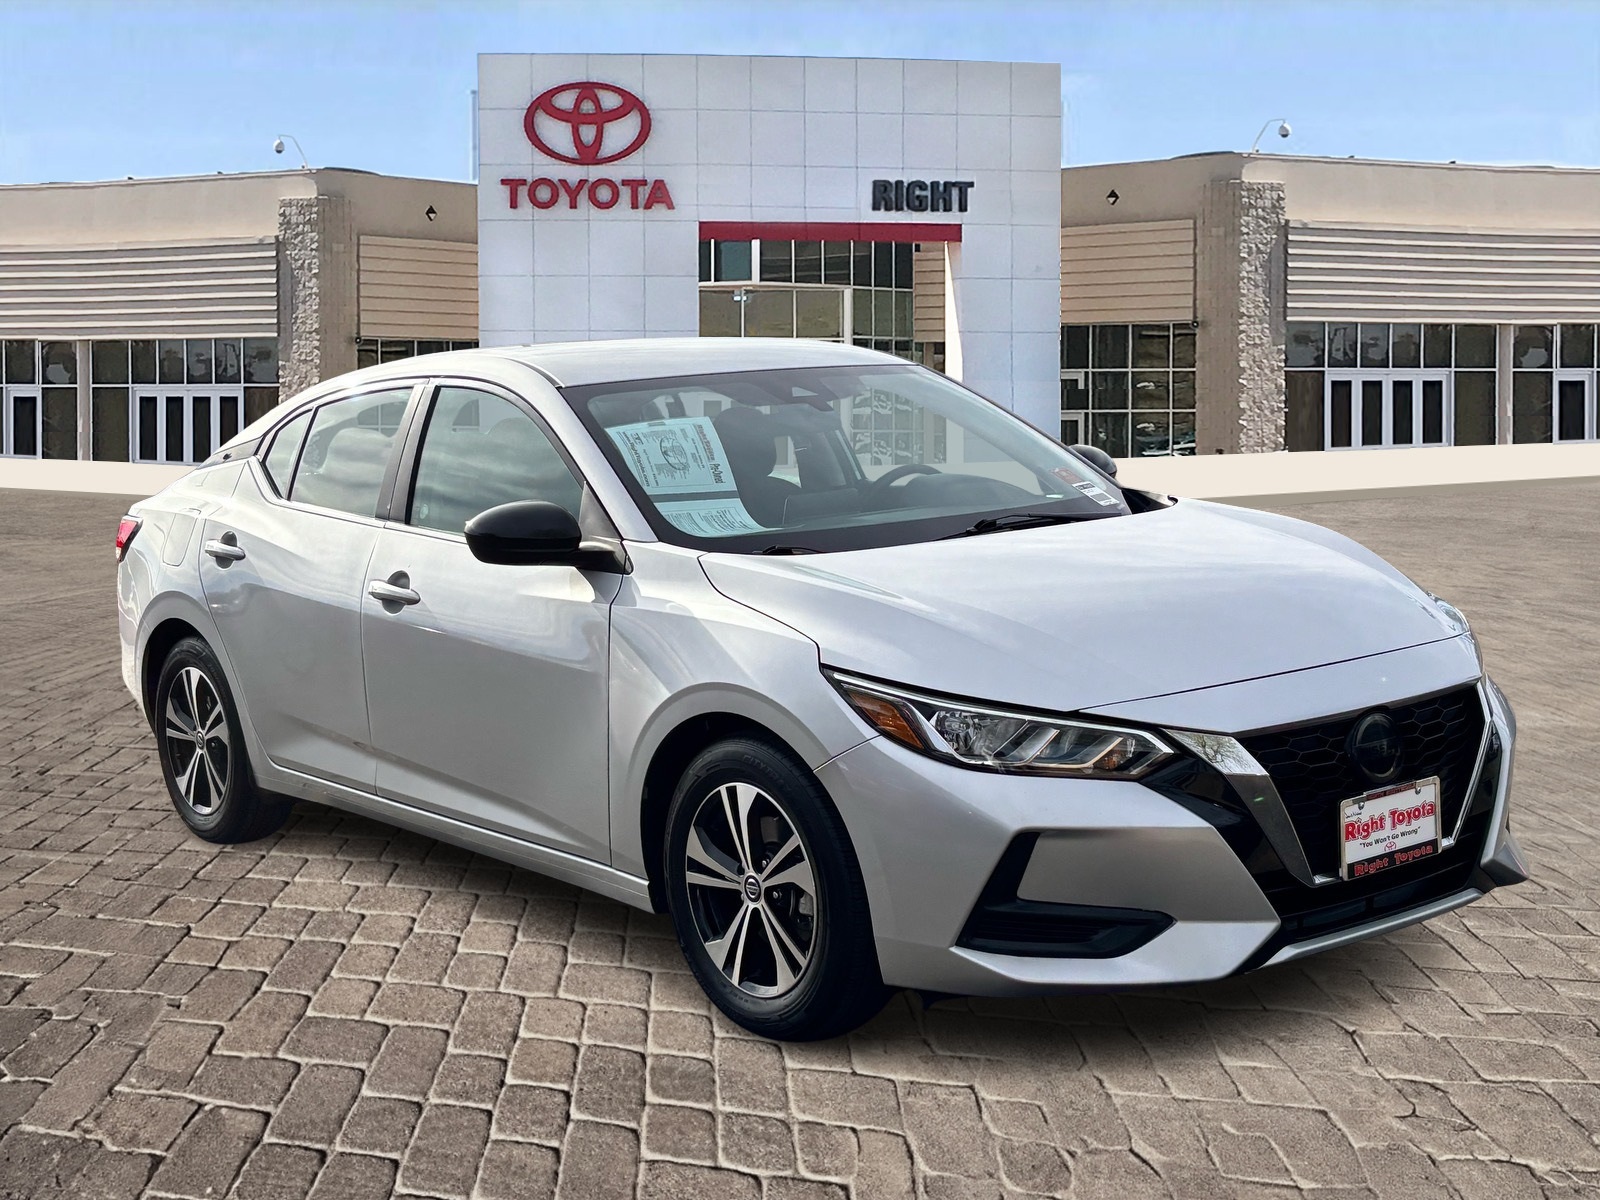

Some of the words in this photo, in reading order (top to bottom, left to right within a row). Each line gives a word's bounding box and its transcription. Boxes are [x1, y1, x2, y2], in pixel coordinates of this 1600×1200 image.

[500, 178, 675, 210] TOYOTA
[872, 180, 975, 212] RIGHT
[1345, 812, 1386, 842] Right
[1389, 800, 1436, 830] Toyota
[1374, 835, 1390, 844] Won't
[1354, 857, 1389, 876] Right
[1394, 845, 1433, 864] Toyota
